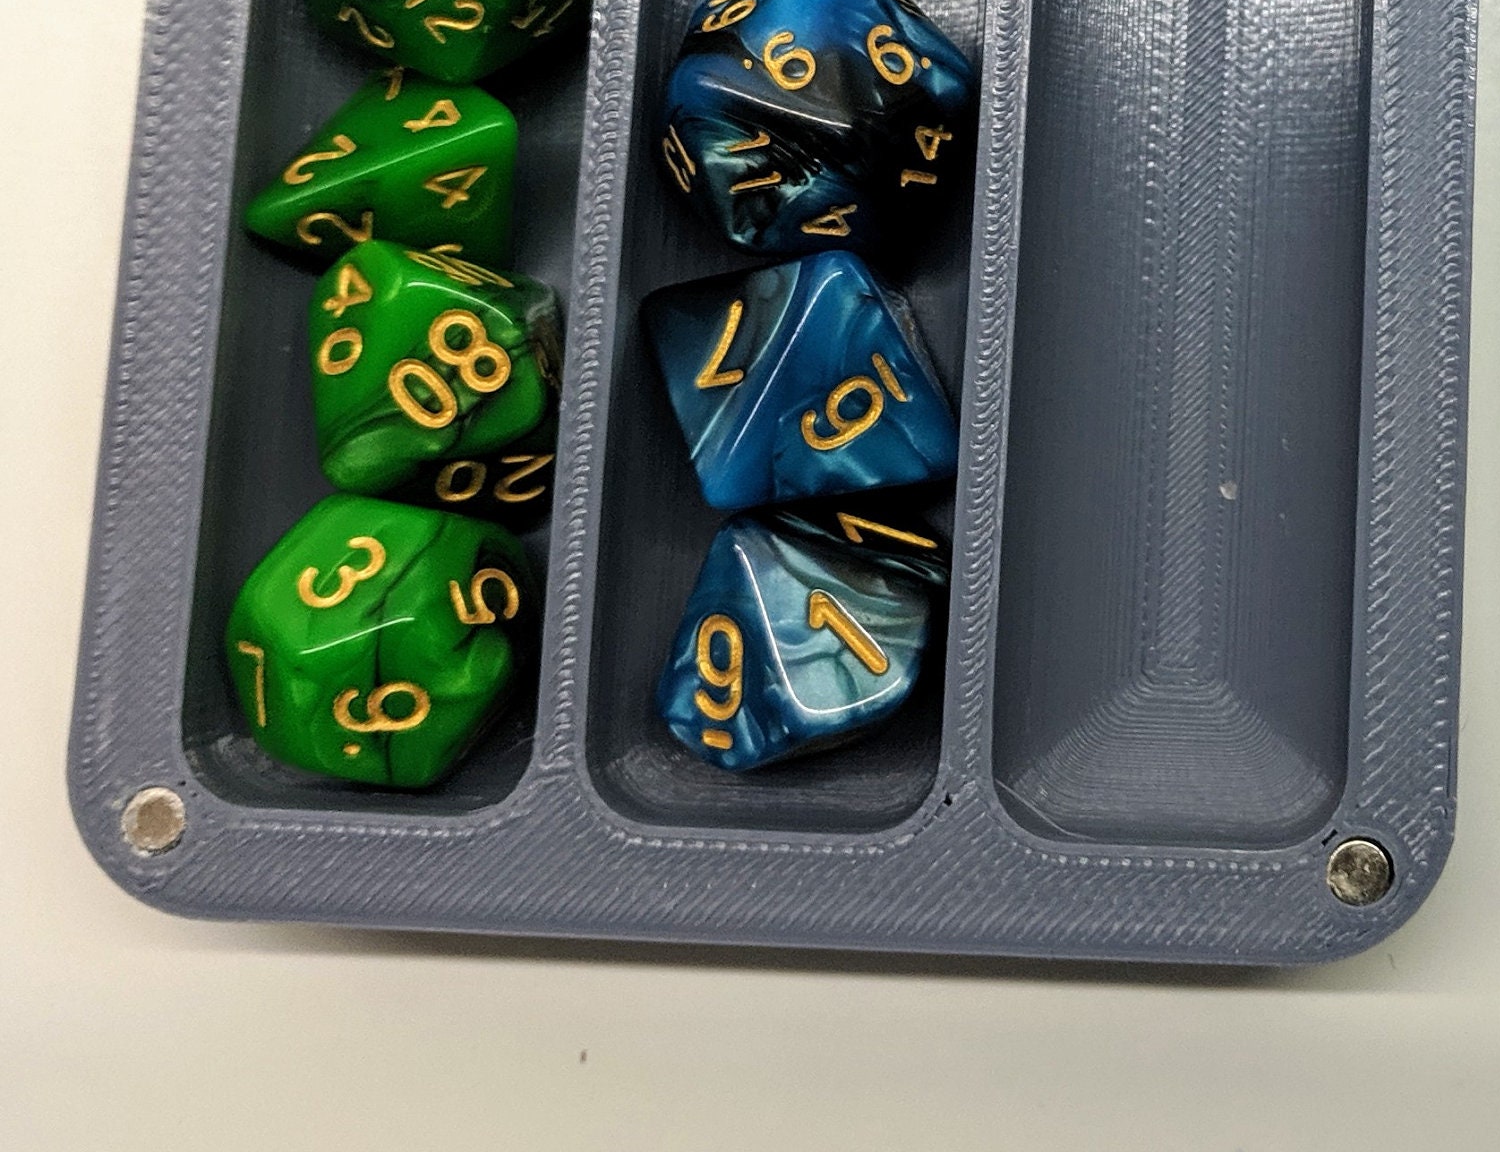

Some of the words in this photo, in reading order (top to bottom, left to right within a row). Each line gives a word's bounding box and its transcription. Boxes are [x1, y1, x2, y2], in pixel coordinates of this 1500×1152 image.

[338, 7, 394, 48] 2
[403, 99, 461, 132] 4
[283, 134, 357, 184] 2
[900, 123, 953, 188] 14
[423, 166, 488, 209] 4
[296, 211, 374, 245] 2
[801, 202, 858, 237] 4
[317, 264, 373, 376] 40
[695, 299, 744, 389] 7
[388, 308, 512, 429] 80
[298, 535, 386, 609] 3
[450, 567, 520, 625] 5
[808, 591, 889, 676] 1
